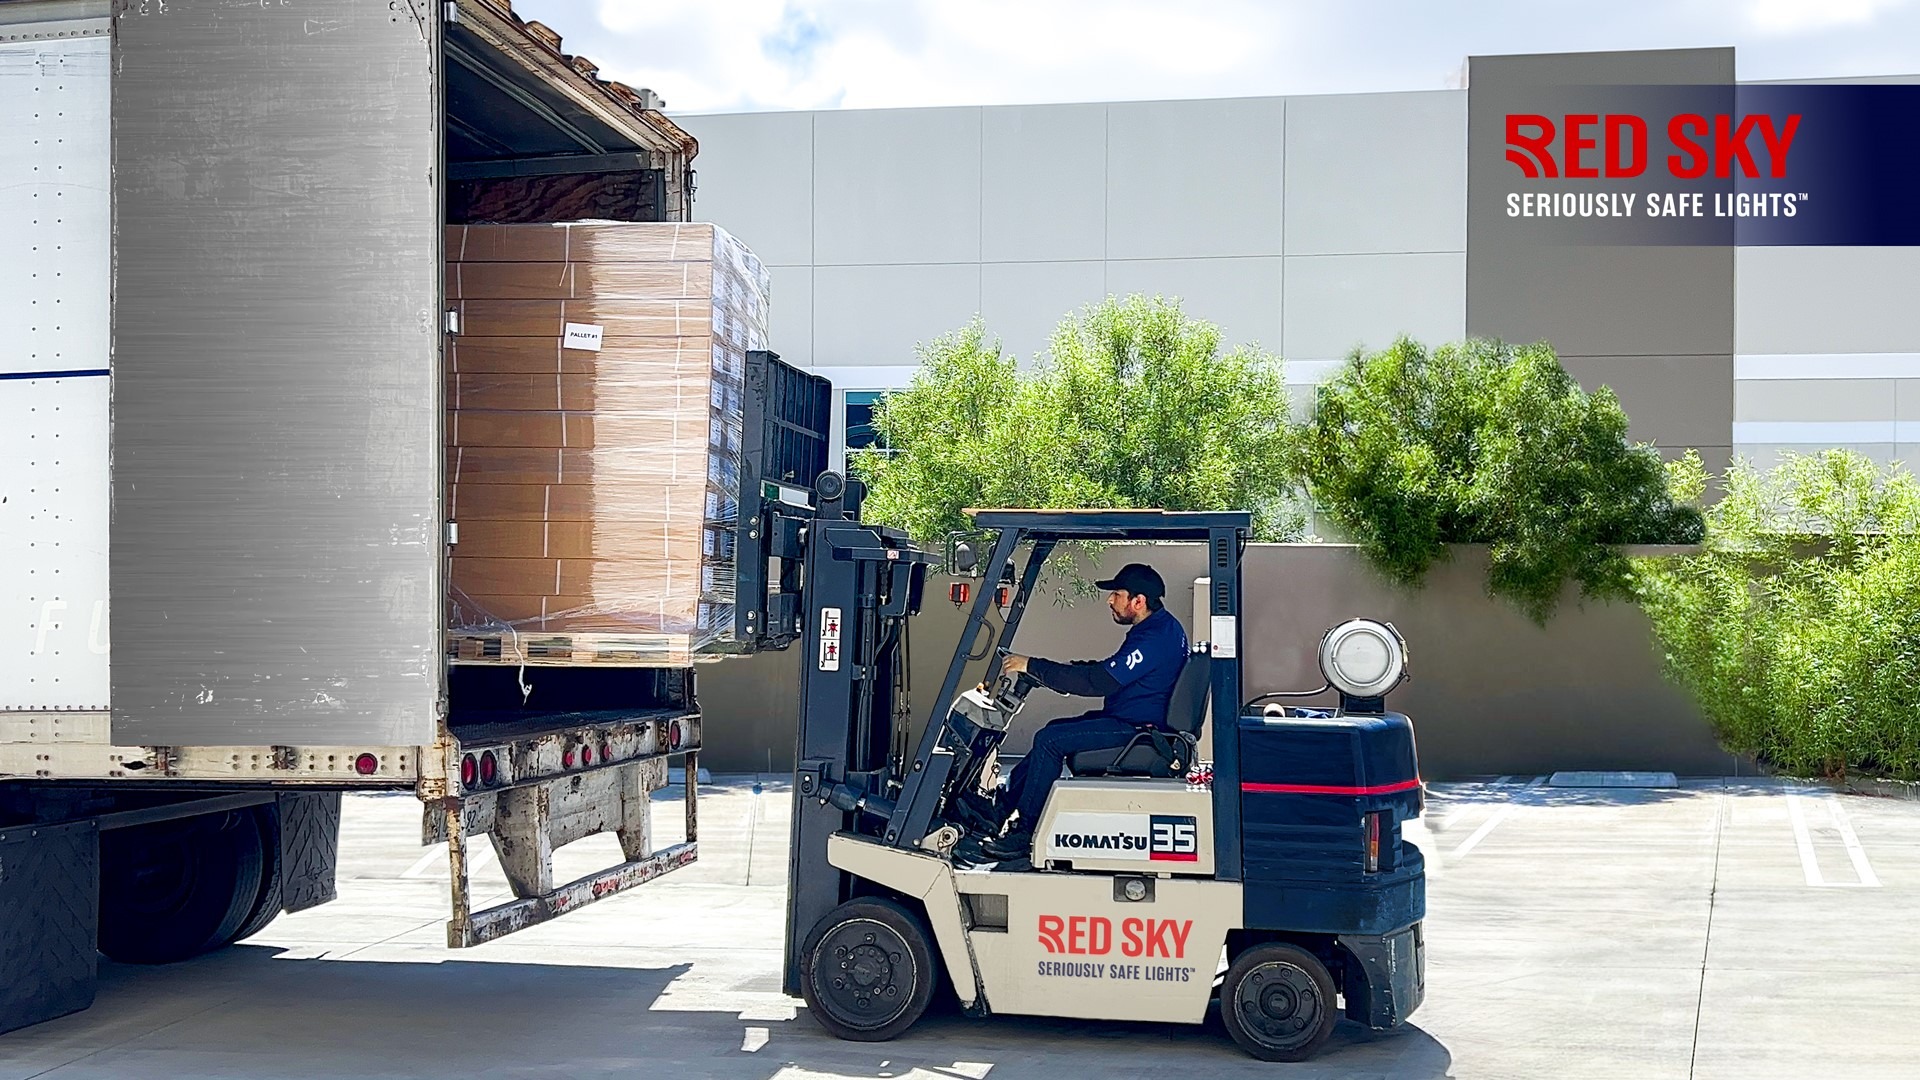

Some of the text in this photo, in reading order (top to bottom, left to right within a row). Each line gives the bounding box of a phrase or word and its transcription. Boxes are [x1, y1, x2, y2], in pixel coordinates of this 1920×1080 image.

[1055, 823, 1196, 853] KOMATSU 35
[1038, 914, 1193, 958] RED SKY
[1038, 961, 1105, 978] SERIOUSLY
[1109, 964, 1140, 980] SAFE
